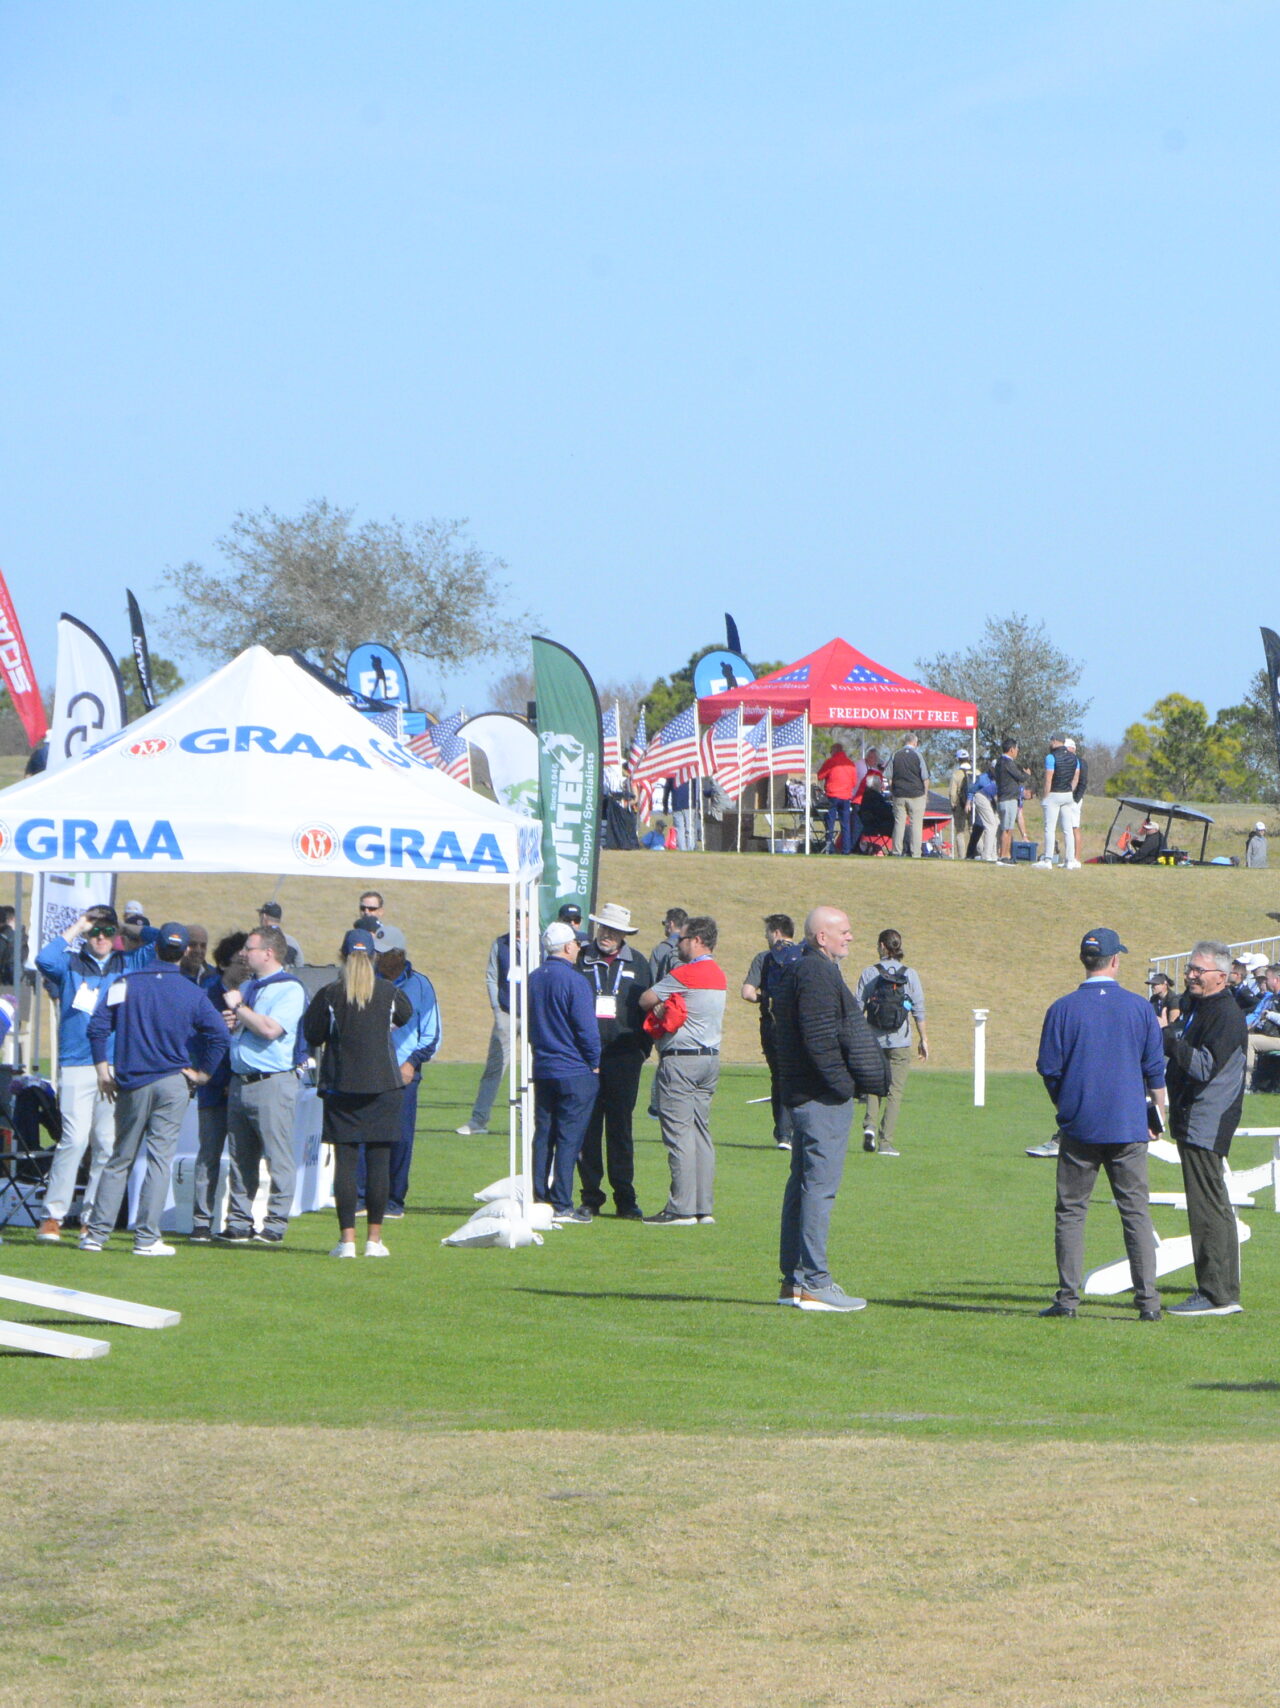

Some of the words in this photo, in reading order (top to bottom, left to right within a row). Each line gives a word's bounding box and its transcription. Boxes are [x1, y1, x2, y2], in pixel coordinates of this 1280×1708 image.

[829, 707, 889, 719] FREEDOM
[893, 709, 925, 721] ISN'T
[927, 710, 959, 722] FREE
[180, 725, 373, 770] GRAA
[583, 752, 595, 819] Specialists
[14, 818, 184, 860] GRAA
[551, 750, 585, 898] WITTEK
[580, 822, 594, 865] Supply
[342, 825, 509, 874] GRAA
[577, 870, 590, 895] Golf
